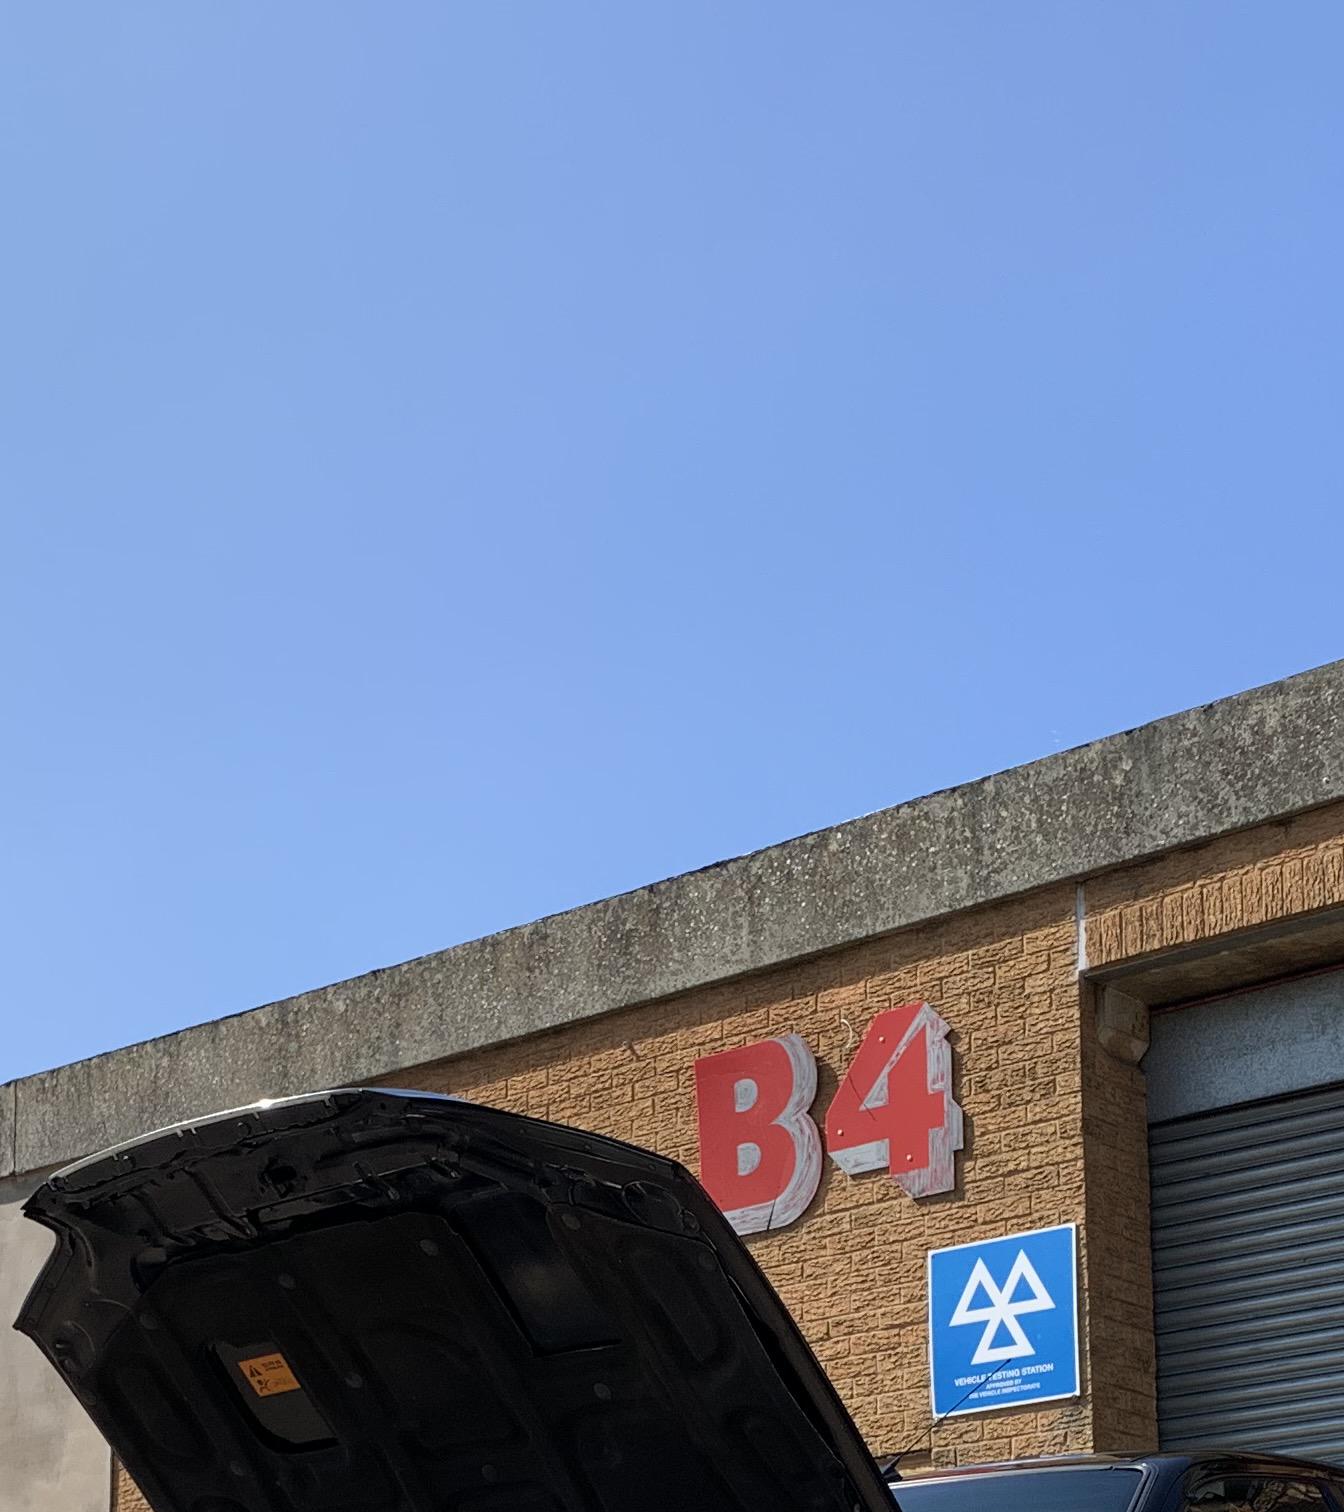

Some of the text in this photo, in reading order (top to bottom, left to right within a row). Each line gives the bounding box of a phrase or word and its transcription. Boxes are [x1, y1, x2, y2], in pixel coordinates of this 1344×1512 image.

[694, 1000, 963, 1236] B4
[954, 1373, 987, 1386] VEHICLE
[1021, 1363, 1054, 1376] STATION
